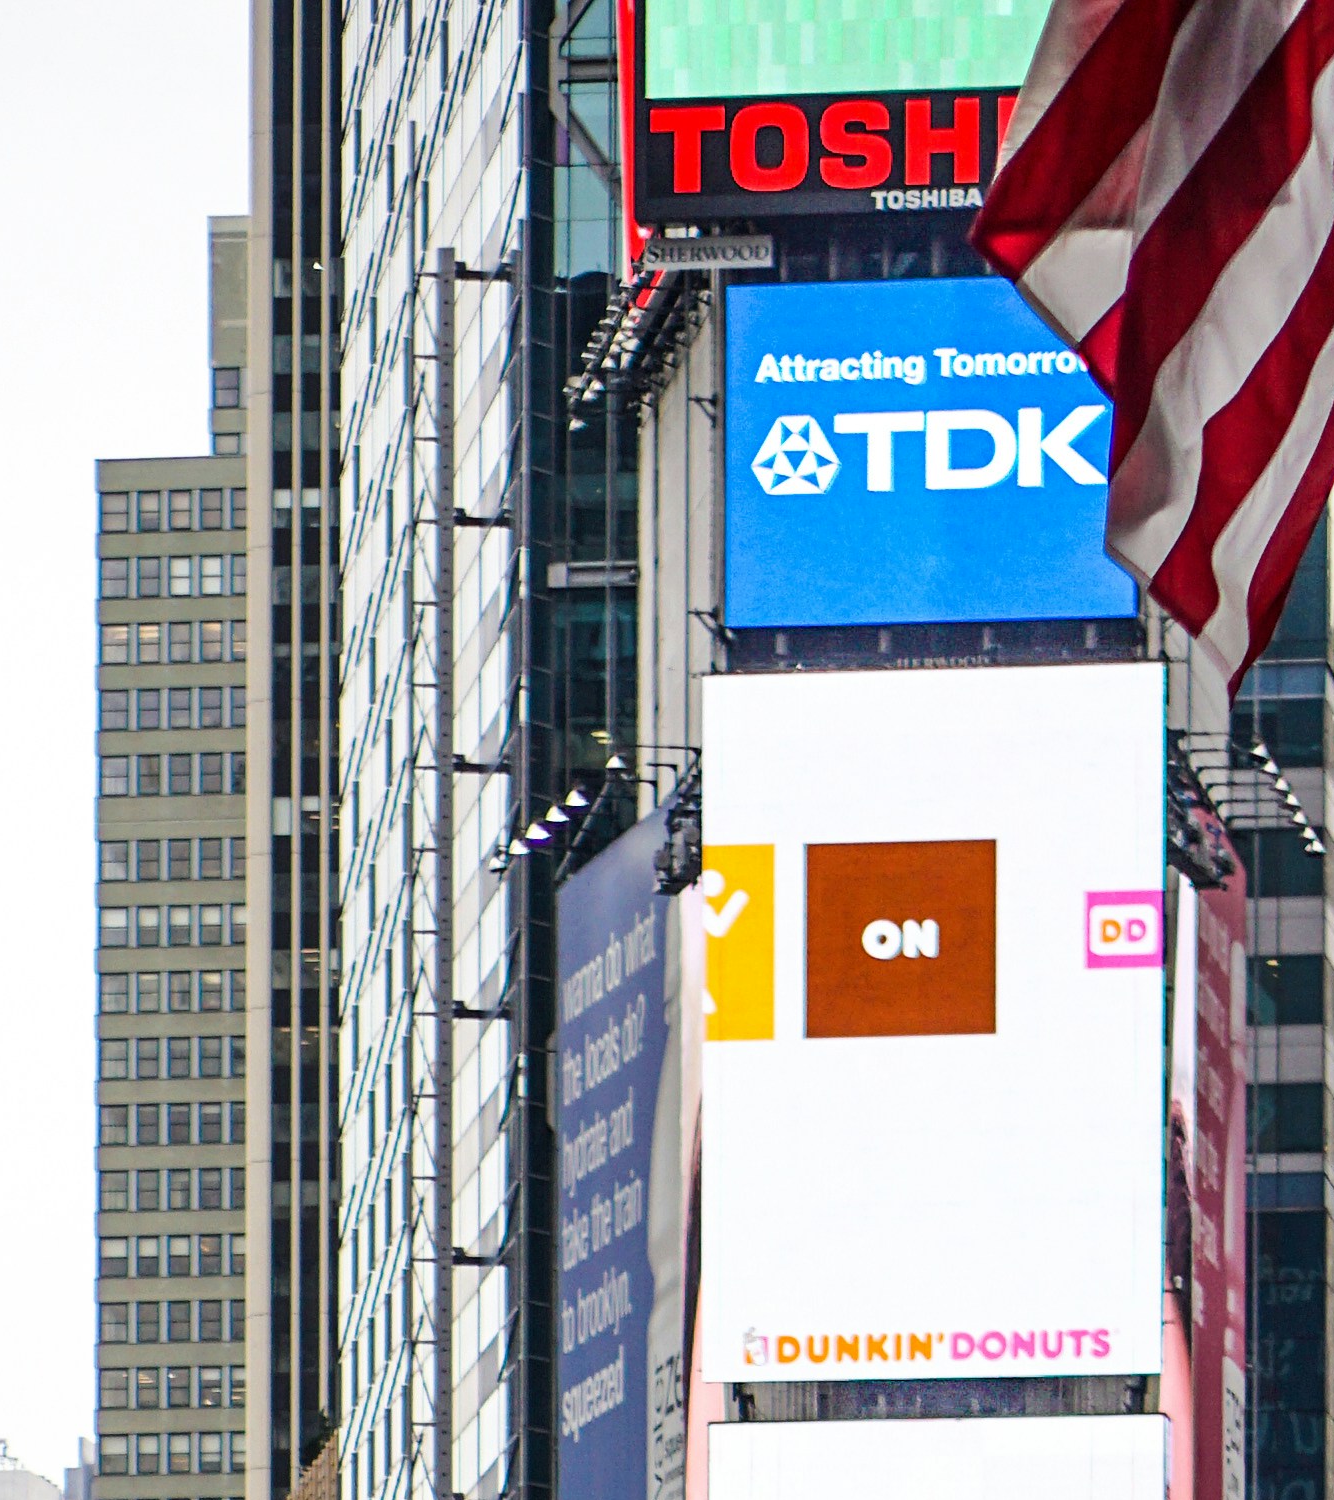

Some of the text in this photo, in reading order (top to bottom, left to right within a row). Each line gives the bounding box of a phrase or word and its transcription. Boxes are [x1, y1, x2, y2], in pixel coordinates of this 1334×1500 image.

[871, 189, 983, 211] TOSHIBA
[645, 241, 770, 265] SHERWOOD
[754, 351, 927, 385] Attracting
[833, 404, 1108, 493] TDK
[624, 902, 657, 977] what
[860, 918, 940, 960] ON
[1098, 917, 1148, 944] DD
[562, 1048, 582, 1106] the
[584, 1016, 619, 1091] locals
[609, 1085, 634, 1158] and
[561, 1169, 643, 1273] take the train
[560, 1296, 576, 1355] to
[775, 1329, 1112, 1365] DUNKIN' DONUTS
[561, 1344, 625, 1442] squeezed
